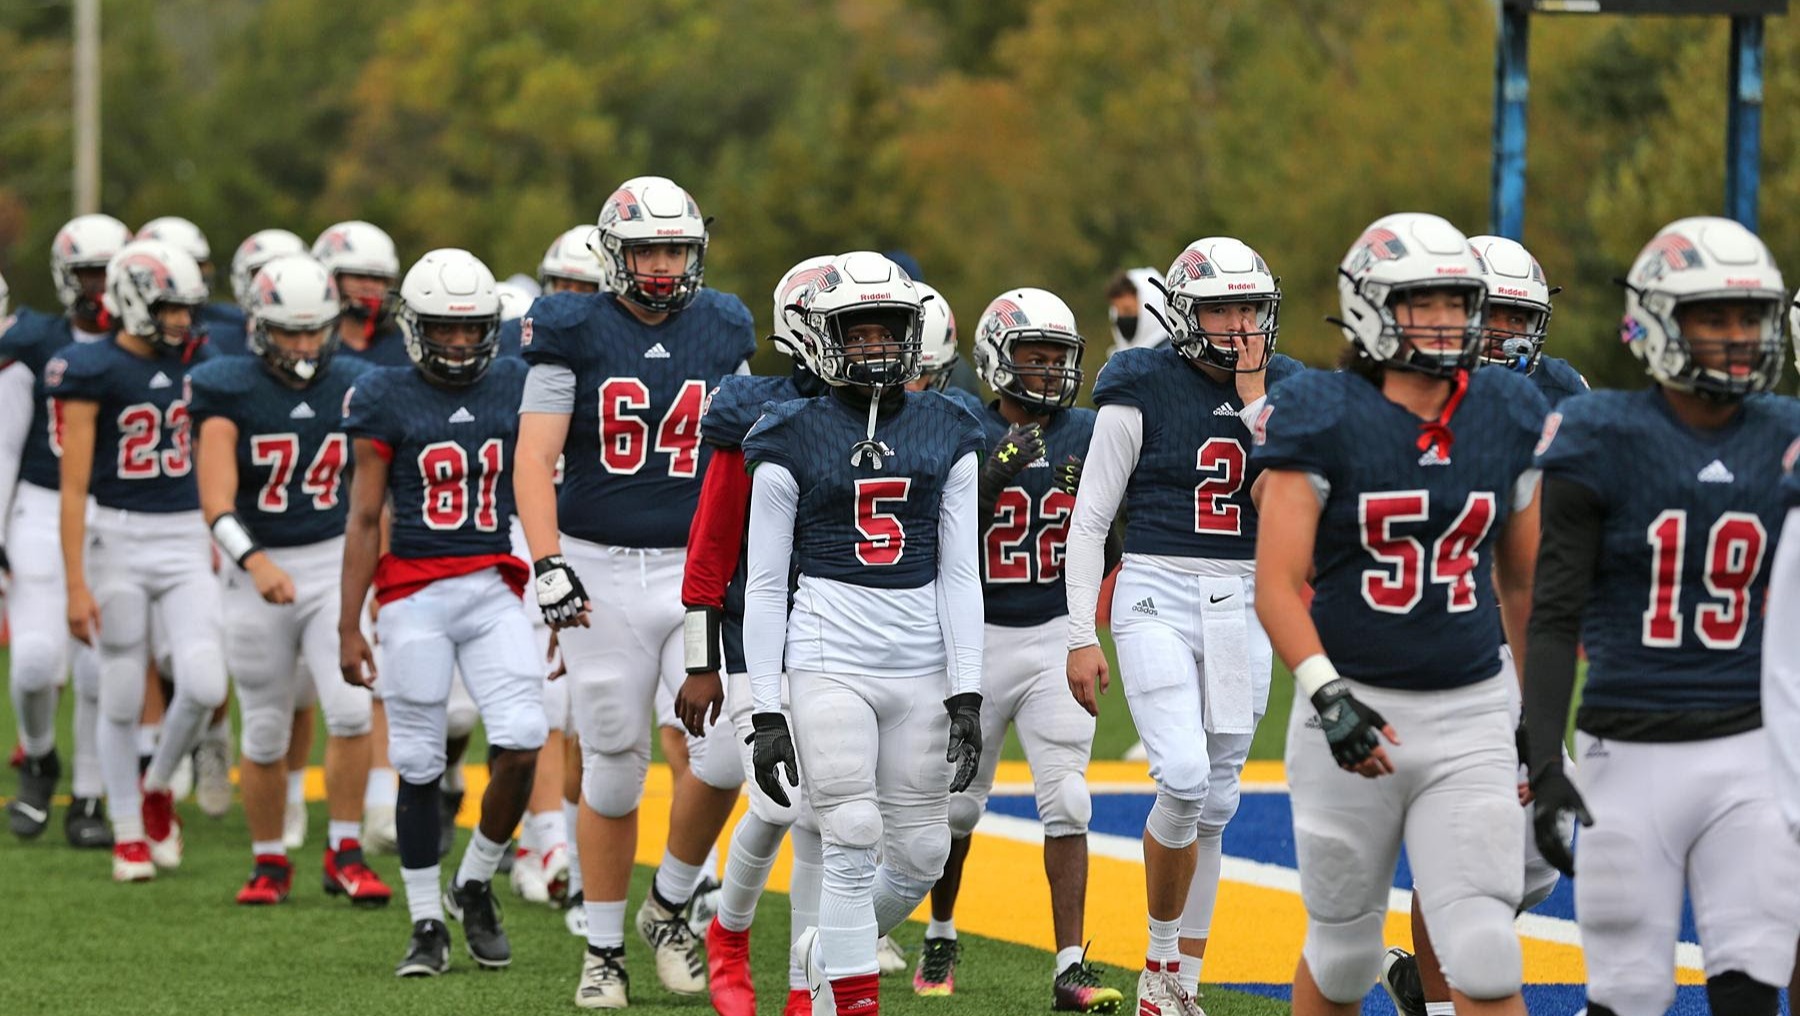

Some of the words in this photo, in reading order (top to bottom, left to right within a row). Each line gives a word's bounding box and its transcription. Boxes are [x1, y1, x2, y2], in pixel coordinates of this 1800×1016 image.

[859, 293, 891, 301] Riddell
[1227, 283, 1257, 291] Riddell
[1497, 287, 1528, 297] Riddell
[118, 400, 192, 480] 23
[598, 377, 706, 478] 64
[250, 432, 348, 513] 74
[417, 438, 504, 533] 81
[1195, 437, 1247, 536] 2
[854, 477, 912, 566] 5
[984, 487, 1074, 583] 22
[1358, 490, 1496, 614] 54
[1131, 604, 1158, 616] adidas
[1642, 509, 1768, 650] 19
